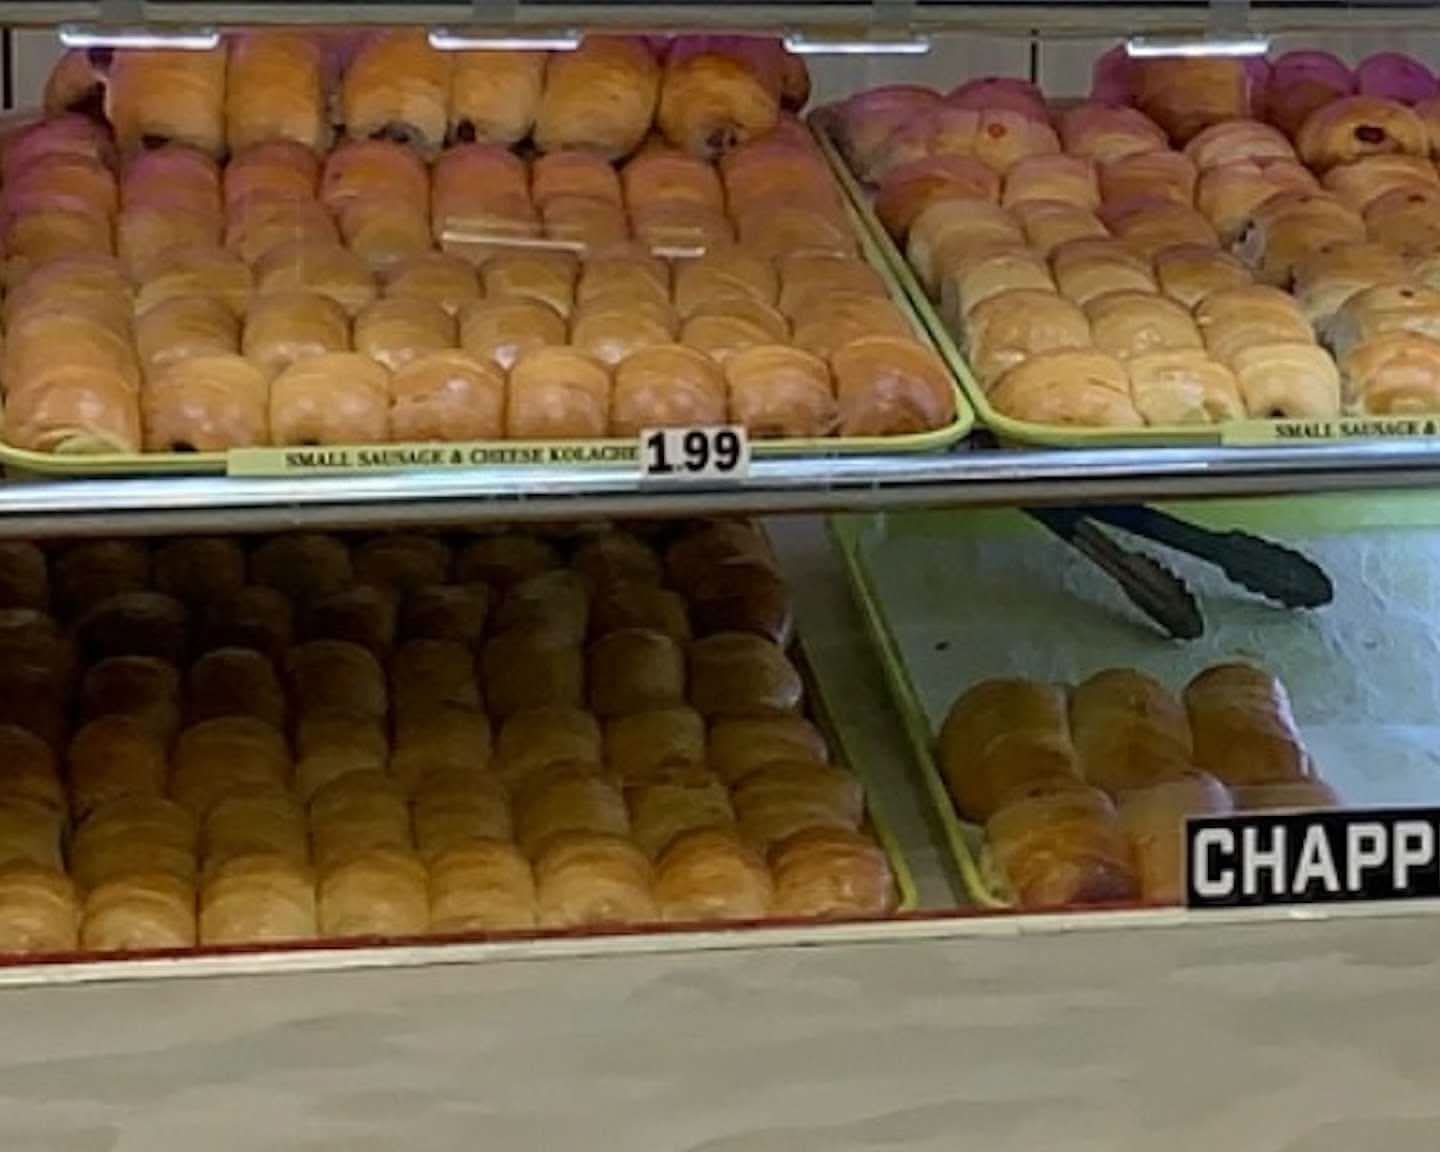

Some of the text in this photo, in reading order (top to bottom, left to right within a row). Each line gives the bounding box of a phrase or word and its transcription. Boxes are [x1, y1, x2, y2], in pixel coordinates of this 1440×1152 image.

[1275, 423, 1331, 438] SMALL
[1340, 421, 1420, 437] SAUSAGE
[1423, 421, 1435, 436] &
[285, 453, 348, 467] SMALL
[357, 449, 444, 466] SAUSAGE
[450, 449, 462, 464] &
[470, 447, 543, 464] CHEESE
[648, 432, 741, 474] 1.99
